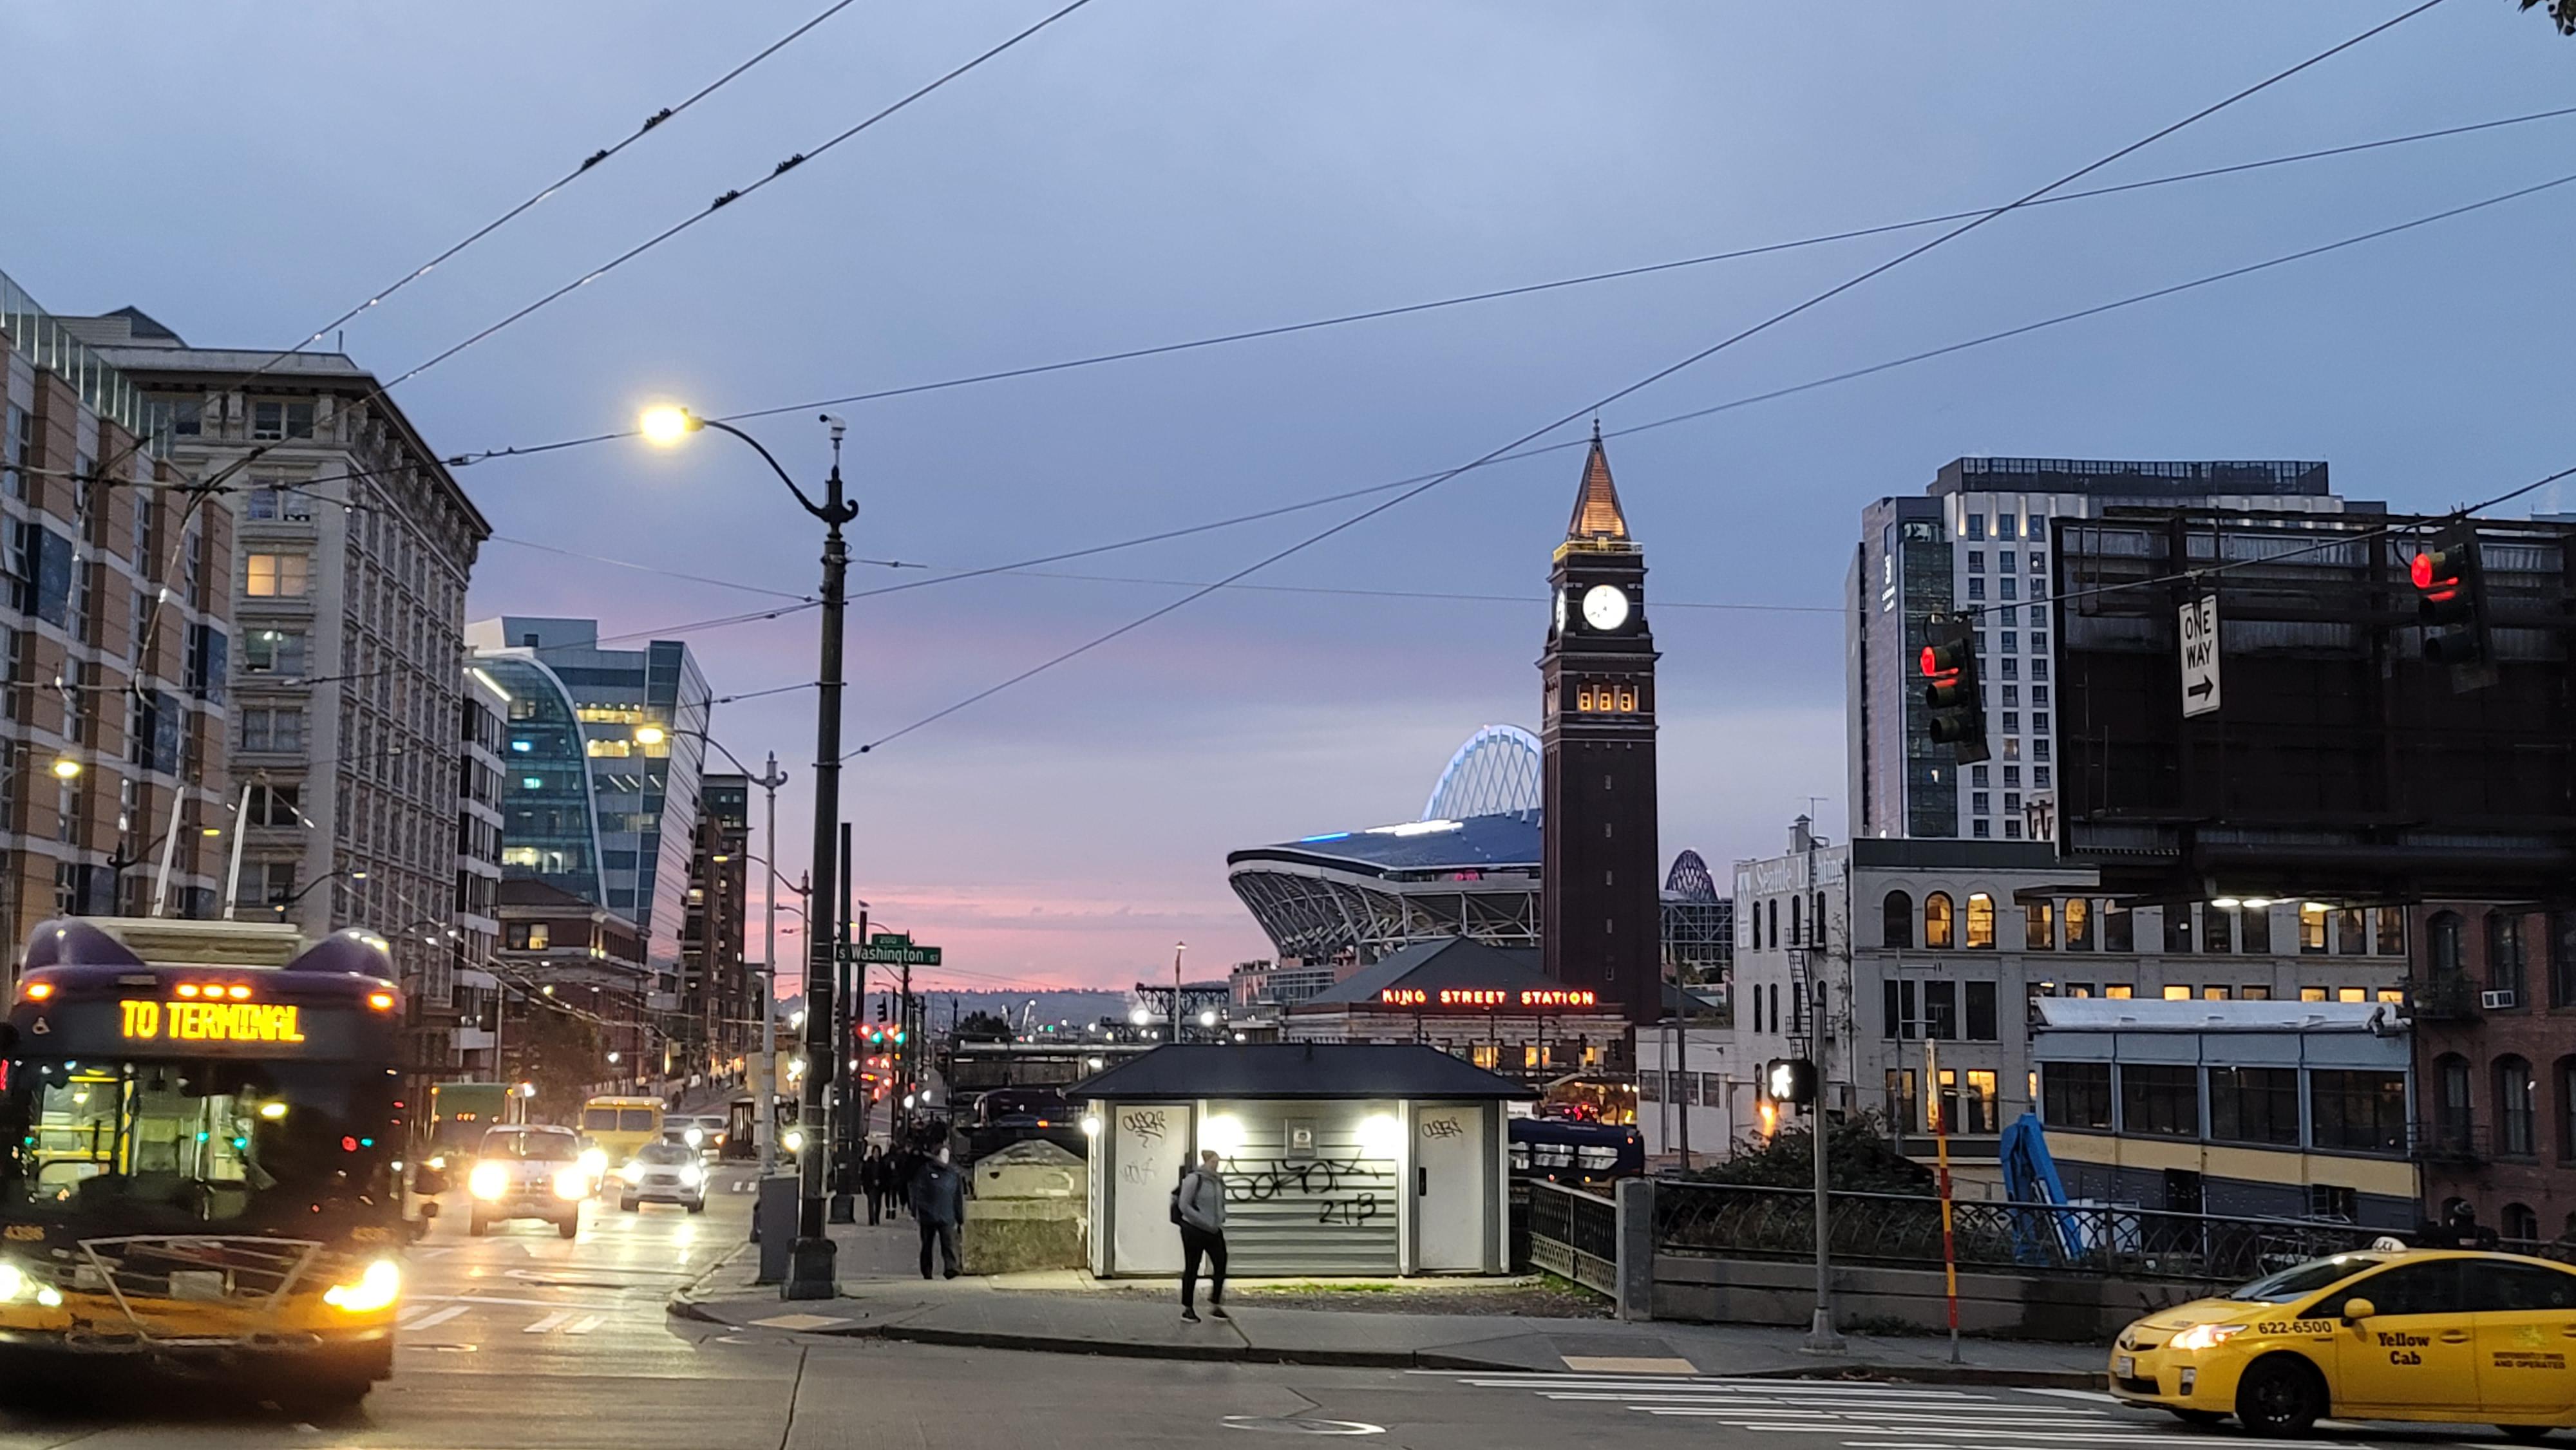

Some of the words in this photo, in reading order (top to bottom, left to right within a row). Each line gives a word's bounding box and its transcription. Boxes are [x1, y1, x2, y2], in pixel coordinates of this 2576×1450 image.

[2185, 610, 2211, 640] ONE
[2186, 639, 2212, 670] WAY
[1756, 859, 1792, 896] Seattle
[1796, 851, 1846, 892] Lihting
[838, 947, 846, 959] S
[851, 945, 924, 966] Washington
[1382, 989, 1426, 1005] KING
[1441, 990, 1506, 1004] STREET
[1520, 991, 1594, 1005] STATION
[120, 1000, 159, 1038] TO
[166, 1002, 305, 1042] TERMINAL
[1320, 1192, 1376, 1226] 2TB
[2259, 1321, 2333, 1334] 622-6500
[2378, 1332, 2430, 1346] Yellow
[2390, 1351, 2422, 1365] Cab
[2516, 1361, 2566, 1370] OPERATED
